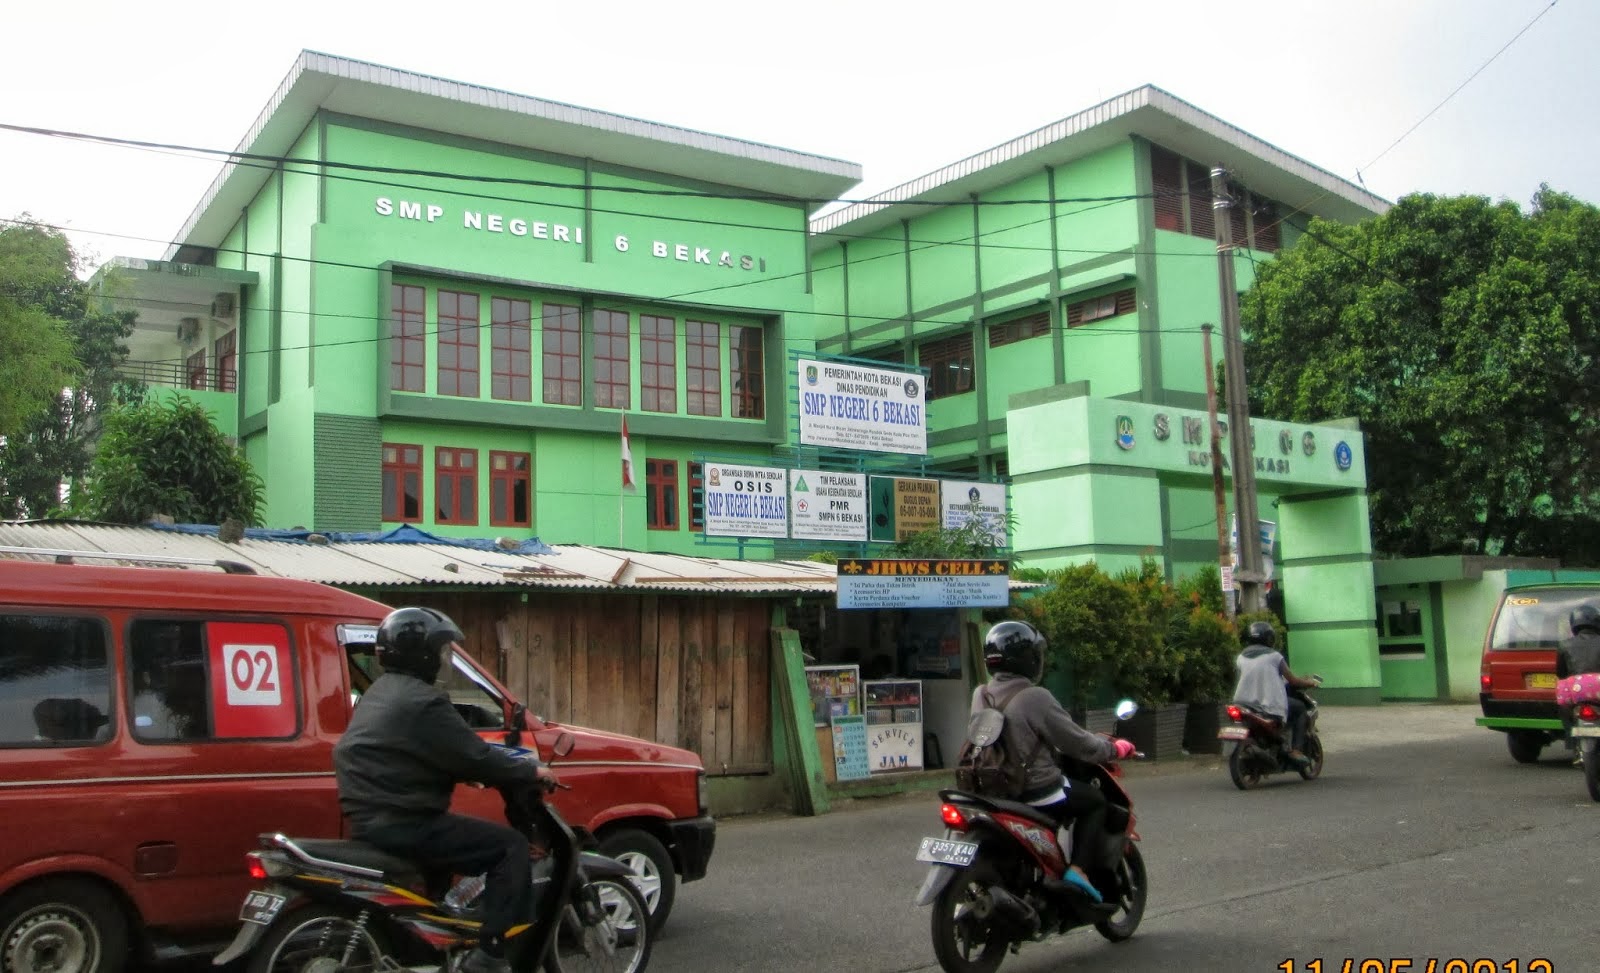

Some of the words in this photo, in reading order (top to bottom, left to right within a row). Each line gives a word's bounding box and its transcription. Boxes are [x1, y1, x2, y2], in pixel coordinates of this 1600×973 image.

[375, 197, 444, 223] SMP
[463, 211, 583, 244] NEGERI
[614, 235, 629, 252] 6
[652, 240, 767, 273] BEKASI
[824, 367, 863, 381] PEMERINTAH
[863, 371, 879, 383] KOTA
[880, 374, 902, 387] BEKASI
[836, 382, 854, 394] DINAS
[855, 384, 888, 398] PENDIDIKAN
[804, 391, 827, 416] SMP
[829, 394, 870, 421] NEGERI
[872, 400, 879, 422] 6
[883, 400, 921, 427] BEKASI
[734, 480, 772, 493] OSIS
[820, 475, 828, 485] TIM
[829, 476, 857, 486] PELAKSANA
[708, 492, 722, 516] SMP
[725, 493, 752, 519] NEGERI
[754, 496, 759, 519] 6
[760, 495, 785, 520] BEKASI
[830, 500, 850, 511] PMR
[818, 511, 836, 522] SMPN
[836, 512, 841, 522] 6
[841, 513, 863, 523] BEKASI
[935, 561, 985, 575] CELL
[231, 649, 275, 691] 02
[872, 728, 915, 749] SERVICE
[879, 755, 908, 768] JAM
[921, 840, 928, 849] B
[933, 841, 955, 852] 3357
[954, 844, 976, 855] KAU
